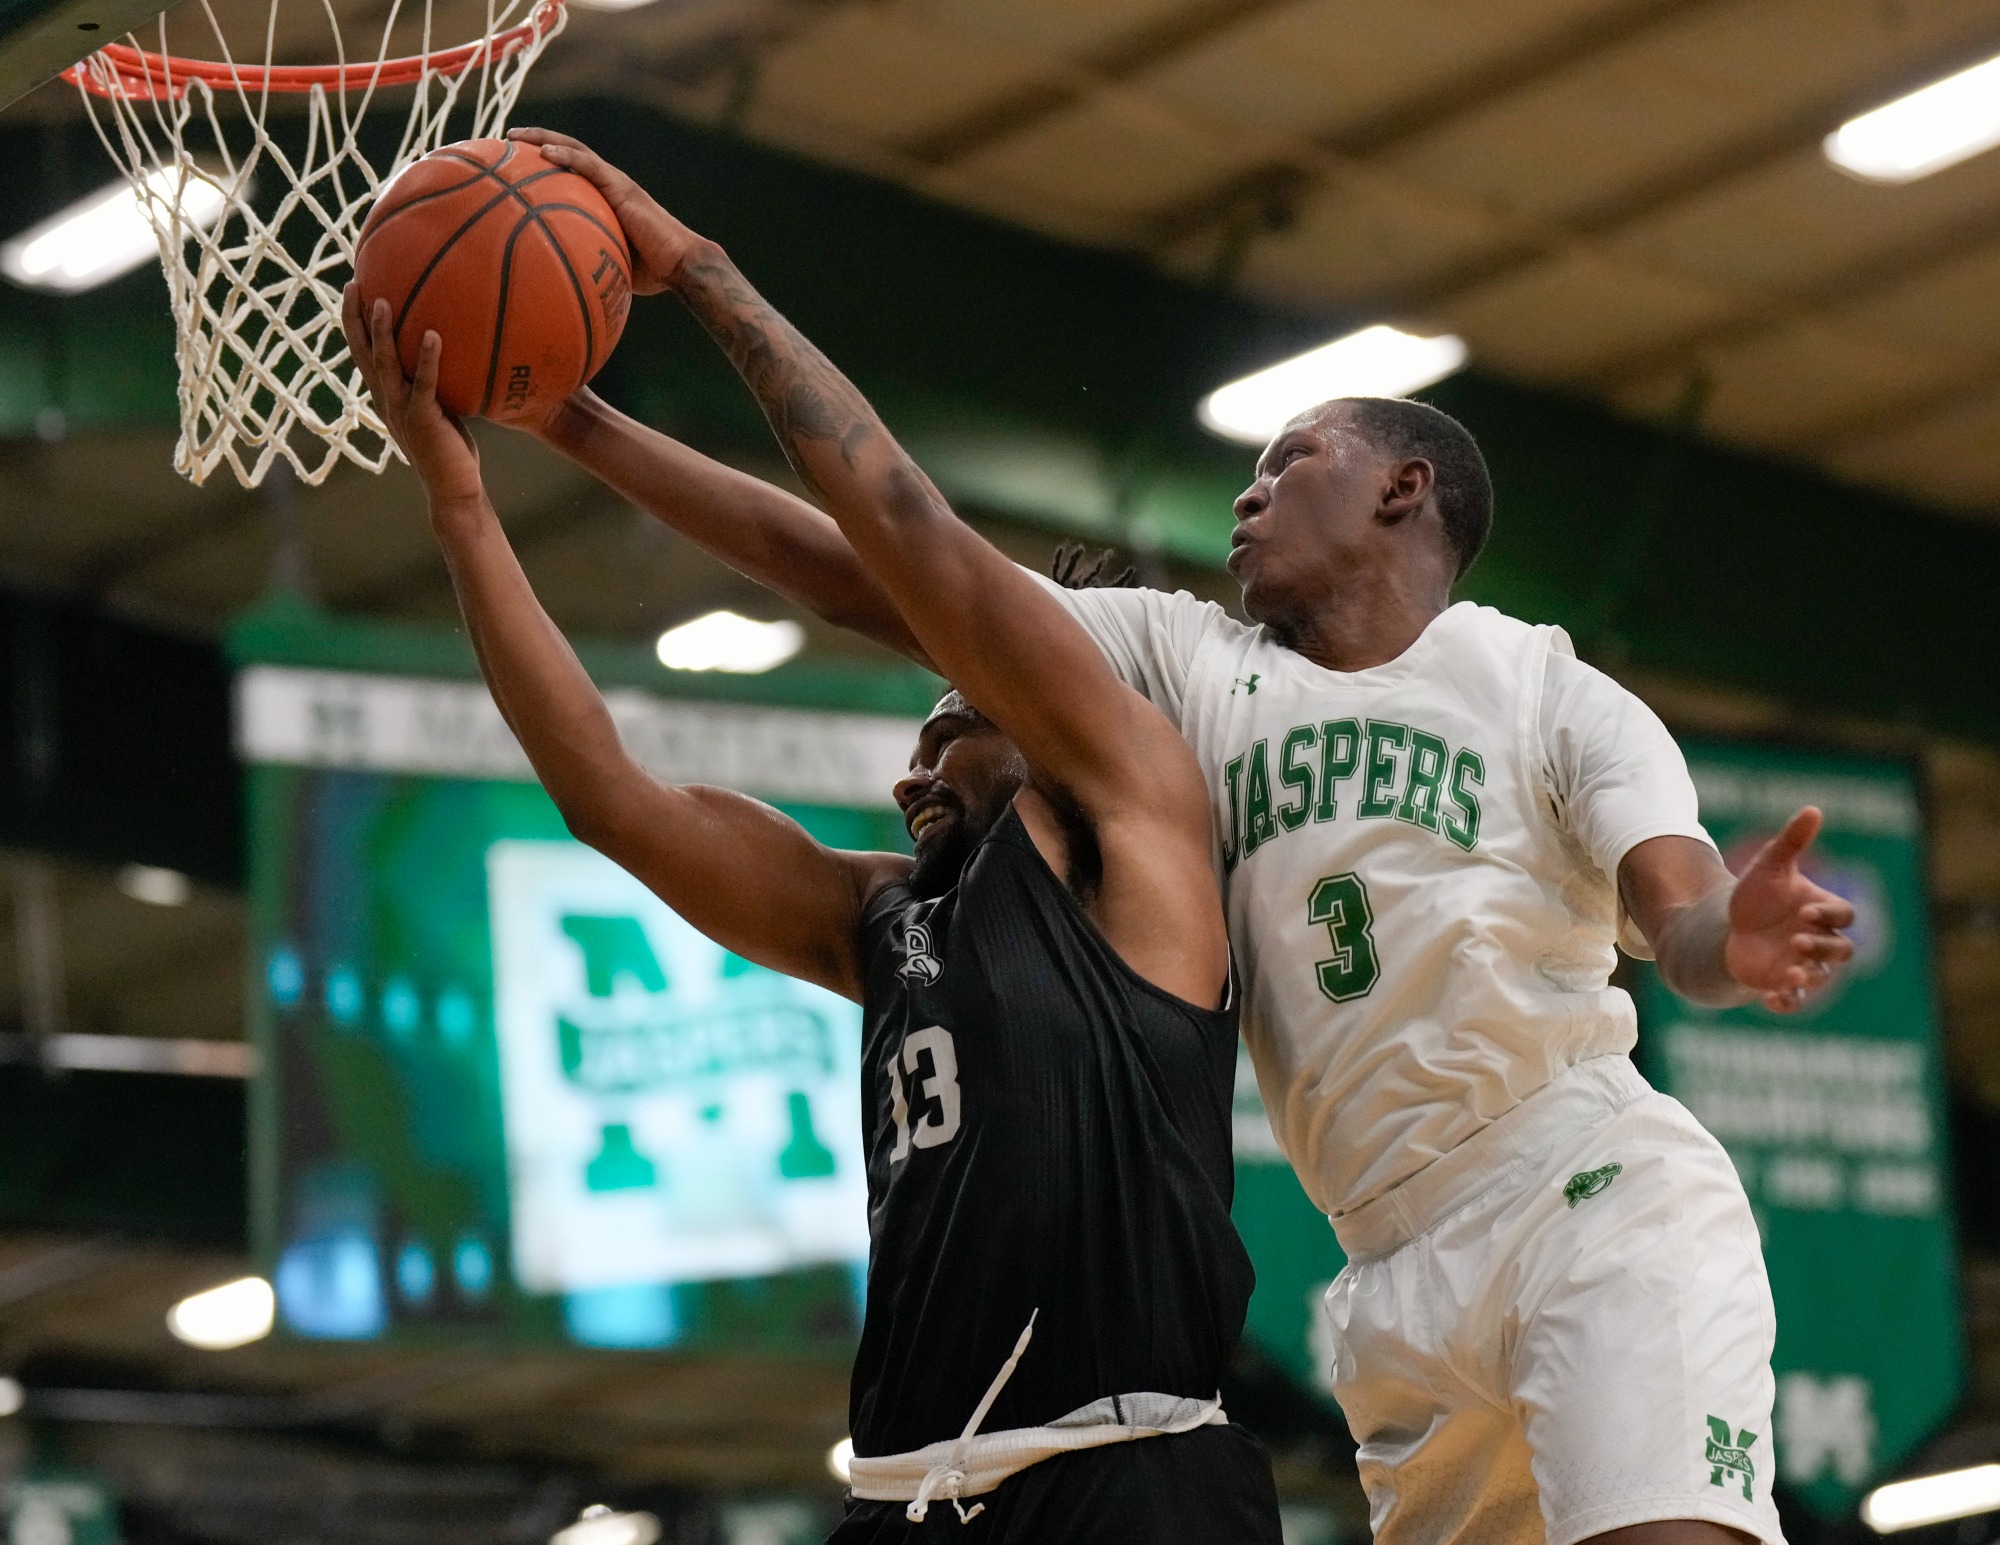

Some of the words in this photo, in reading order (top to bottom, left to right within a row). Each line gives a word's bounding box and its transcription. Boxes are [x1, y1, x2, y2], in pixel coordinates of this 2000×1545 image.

[1223, 717, 1485, 881] JASPERS
[1307, 871, 1381, 1004] 3
[888, 1025, 961, 1166] 13
[1708, 1446, 1751, 1471] JASPRS
